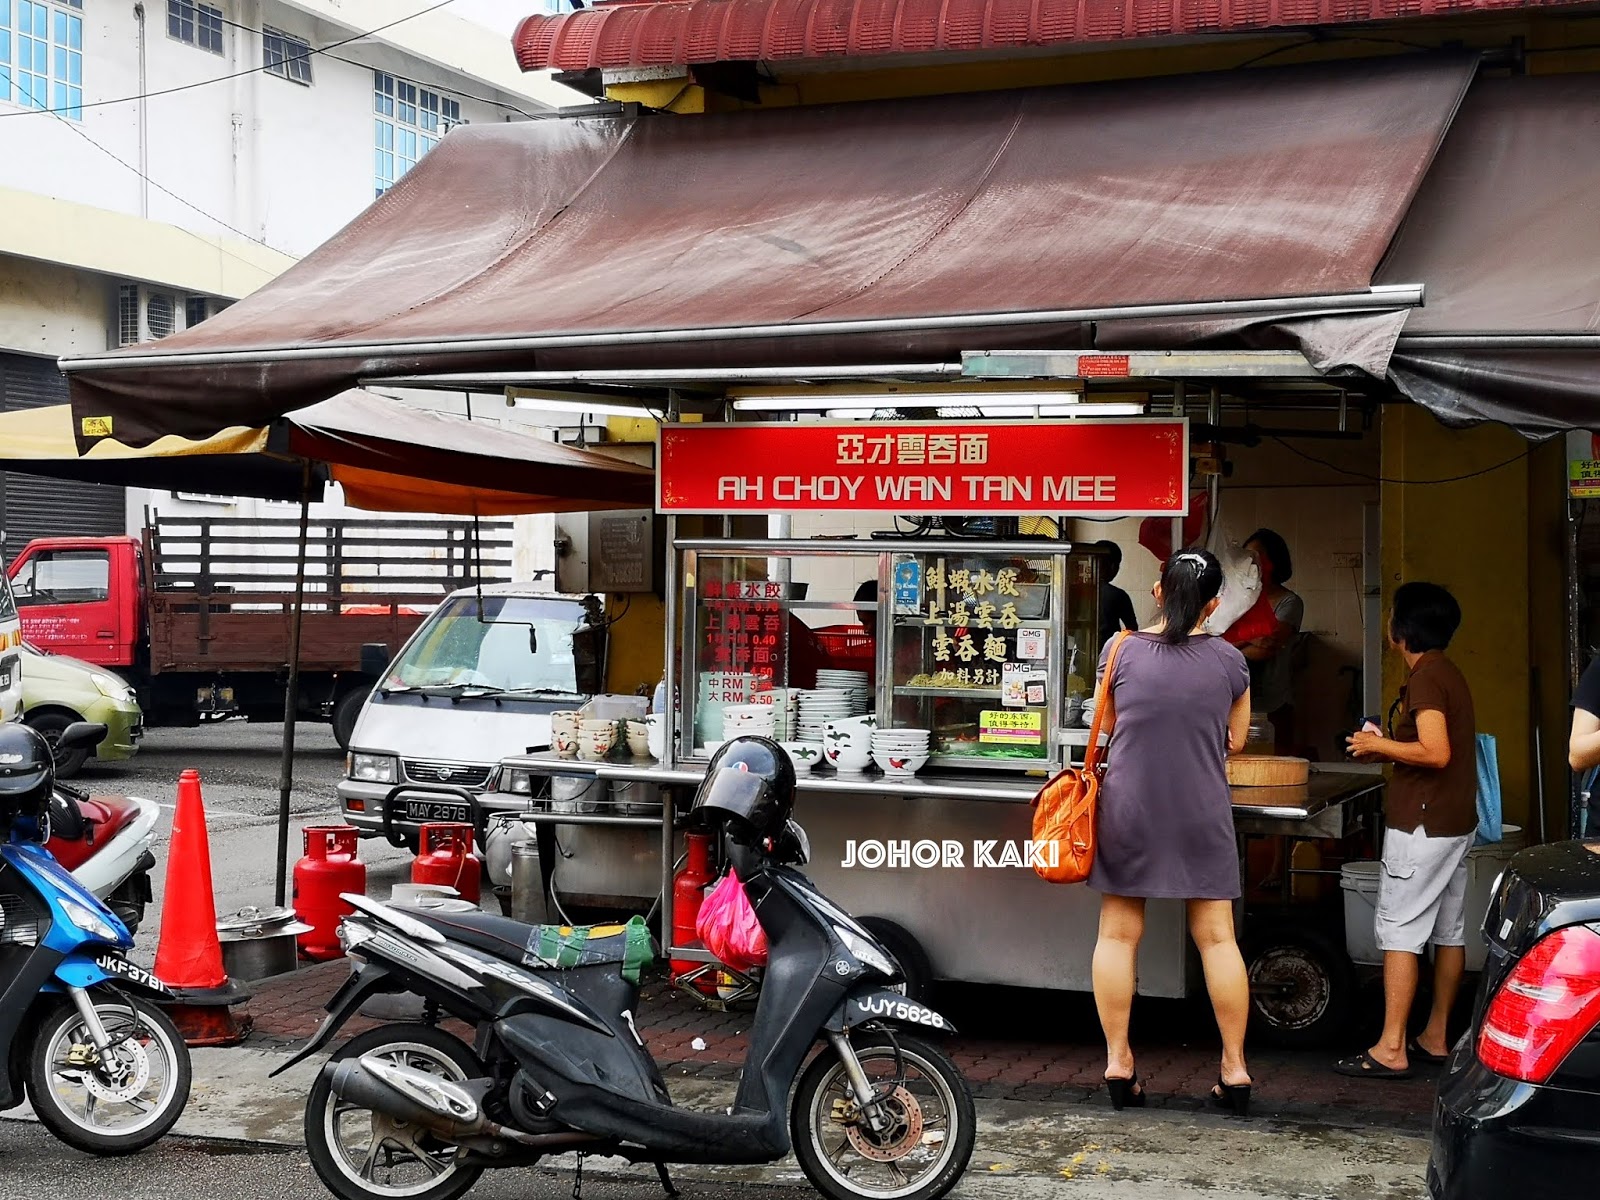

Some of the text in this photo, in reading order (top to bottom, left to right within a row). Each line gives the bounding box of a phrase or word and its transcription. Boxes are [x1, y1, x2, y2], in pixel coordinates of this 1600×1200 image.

[836, 433, 988, 464] 亞才雲吞面
[718, 476, 1116, 501] AH CHOY WAN TAN MEE
[926, 566, 1019, 596] 鮮蝦水餃
[923, 600, 1022, 631] 上湯雲吞
[752, 635, 776, 645] 0.40
[932, 633, 1008, 662] 雲吞麵
[708, 678, 719, 688] 中
[722, 679, 743, 689] RM
[939, 668, 1000, 685] 加料另計
[708, 691, 773, 704] 大 RM 5.50
[409, 803, 466, 820] MAY 2878
[858, 996, 944, 1028] JJY5626
